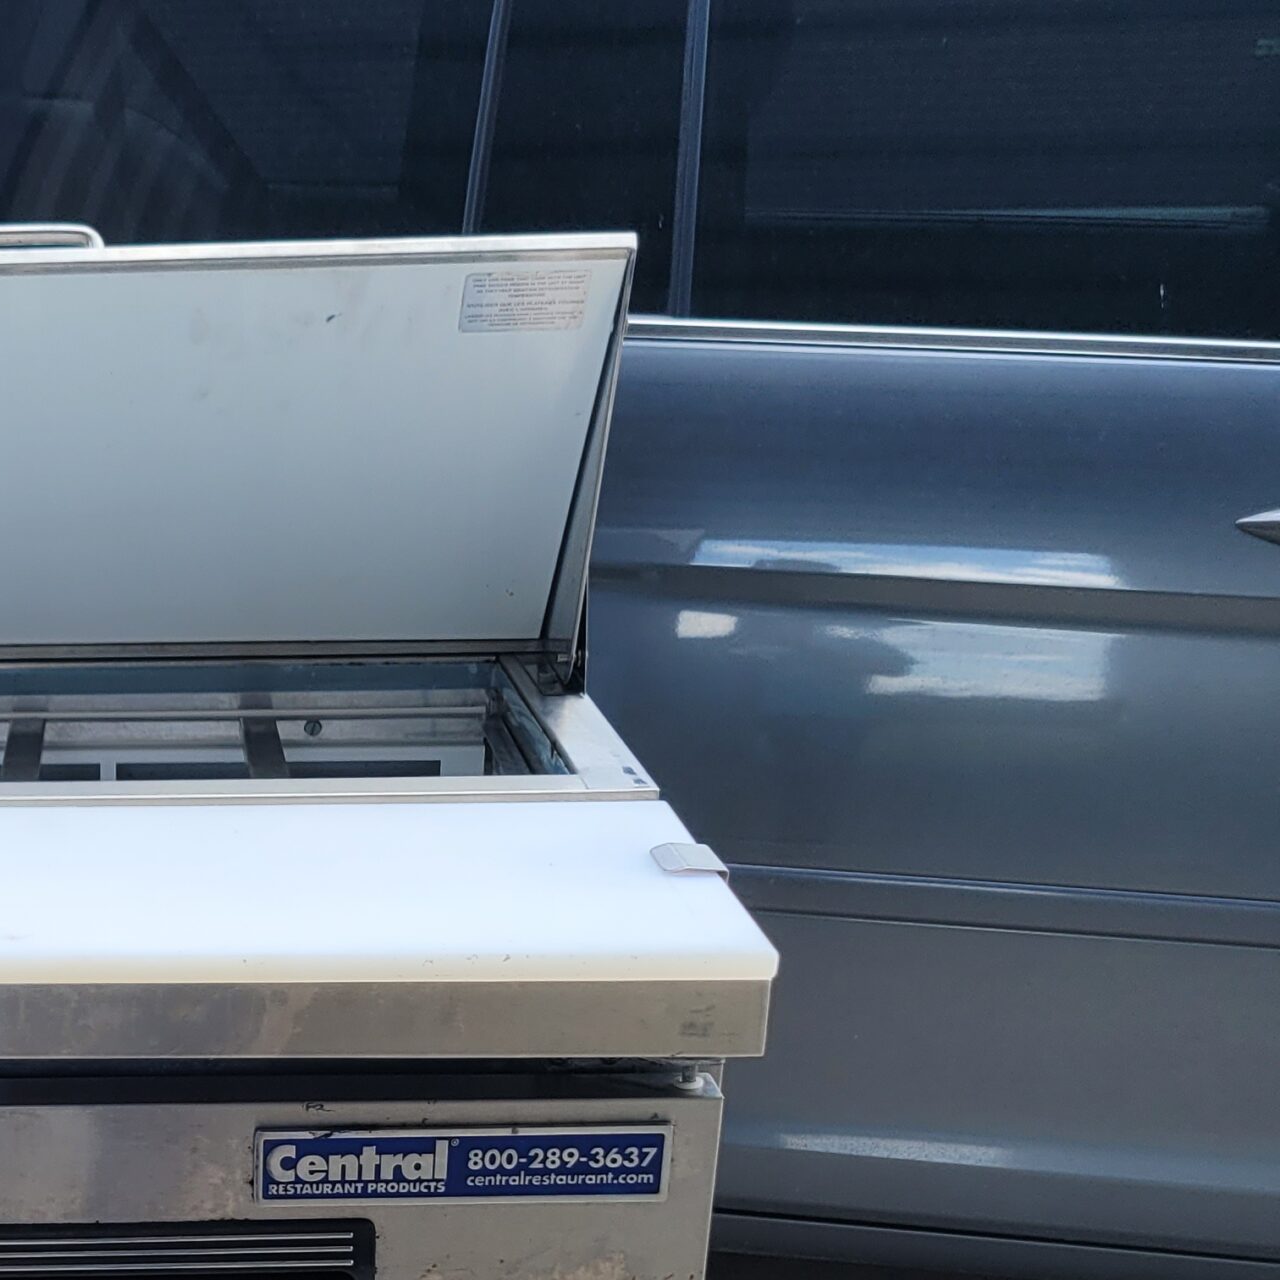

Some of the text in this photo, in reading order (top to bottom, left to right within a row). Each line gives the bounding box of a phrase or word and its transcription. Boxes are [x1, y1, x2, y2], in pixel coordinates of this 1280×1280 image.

[267, 1140, 448, 1182] Central
[467, 1147, 657, 1169] 800-289-3637
[268, 1180, 446, 1195] RESTAURANT PRODUCTS
[466, 1171, 654, 1186] centralrestaurant.com
